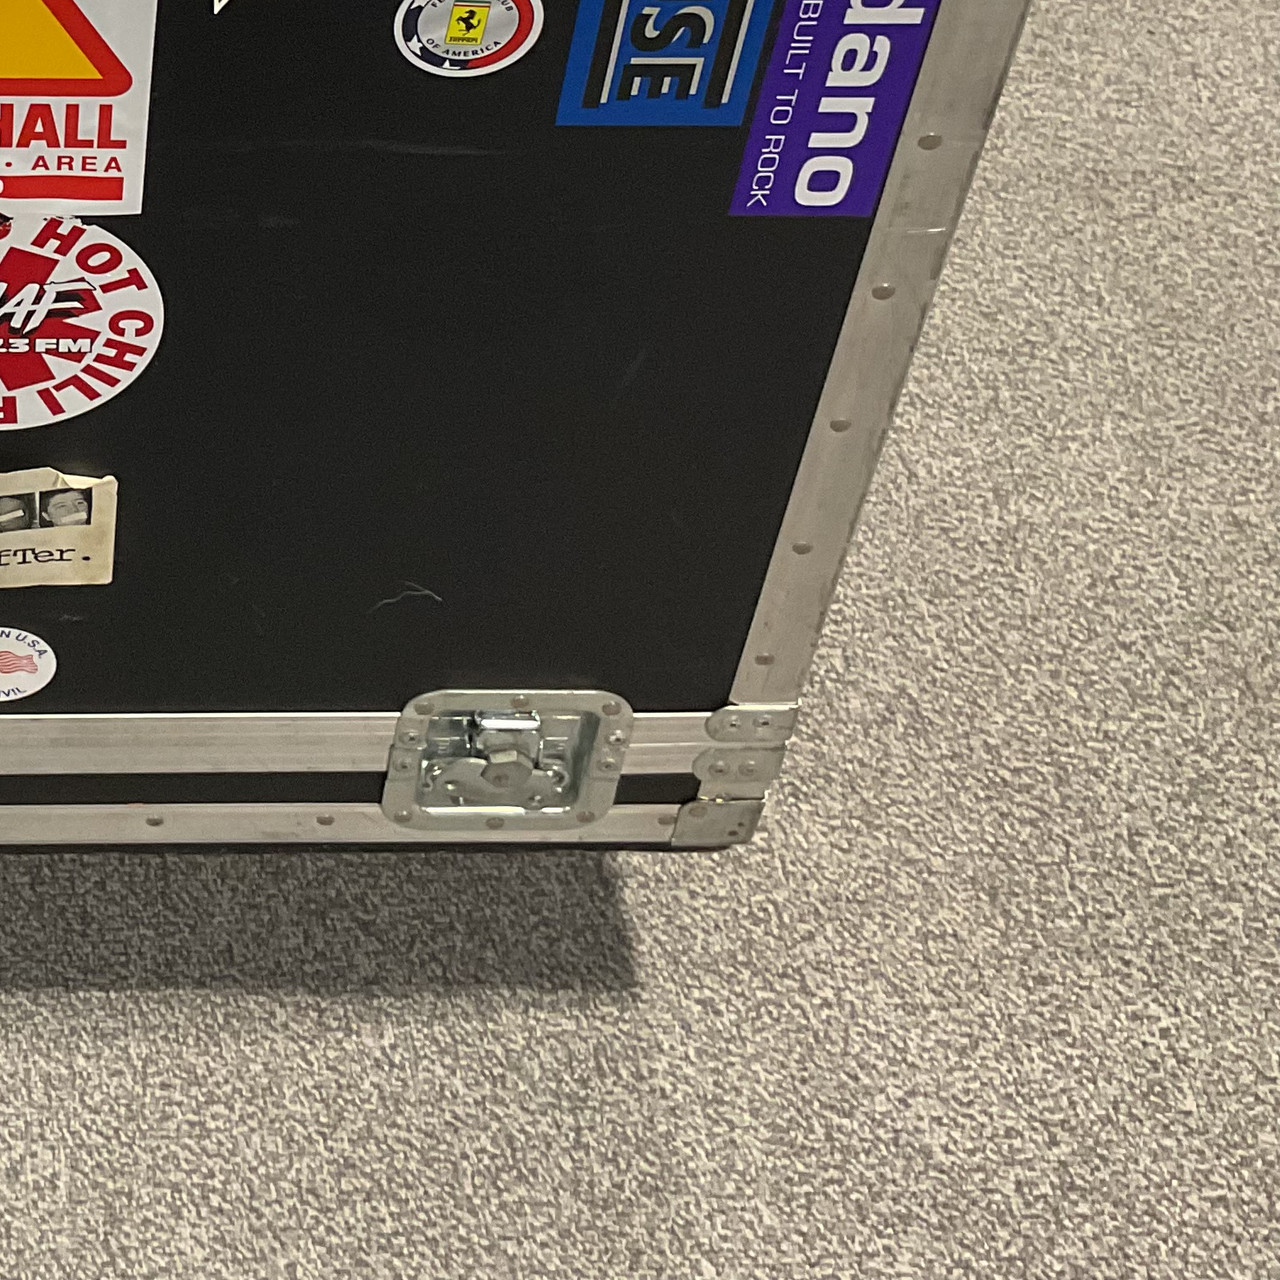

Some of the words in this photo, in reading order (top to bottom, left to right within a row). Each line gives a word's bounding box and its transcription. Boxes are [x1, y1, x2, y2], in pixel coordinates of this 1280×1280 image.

[426, 38, 441, 50] OF
[442, 40, 502, 58] AMERICA
[784, 0, 824, 80] BUILT
[769, 88, 799, 125] TO
[31, 154, 123, 173] AREA
[747, 134, 786, 207] ROCK
[30, 217, 149, 294] HOT
[34, 337, 92, 353] FM
[36, 309, 155, 417] CHILI
